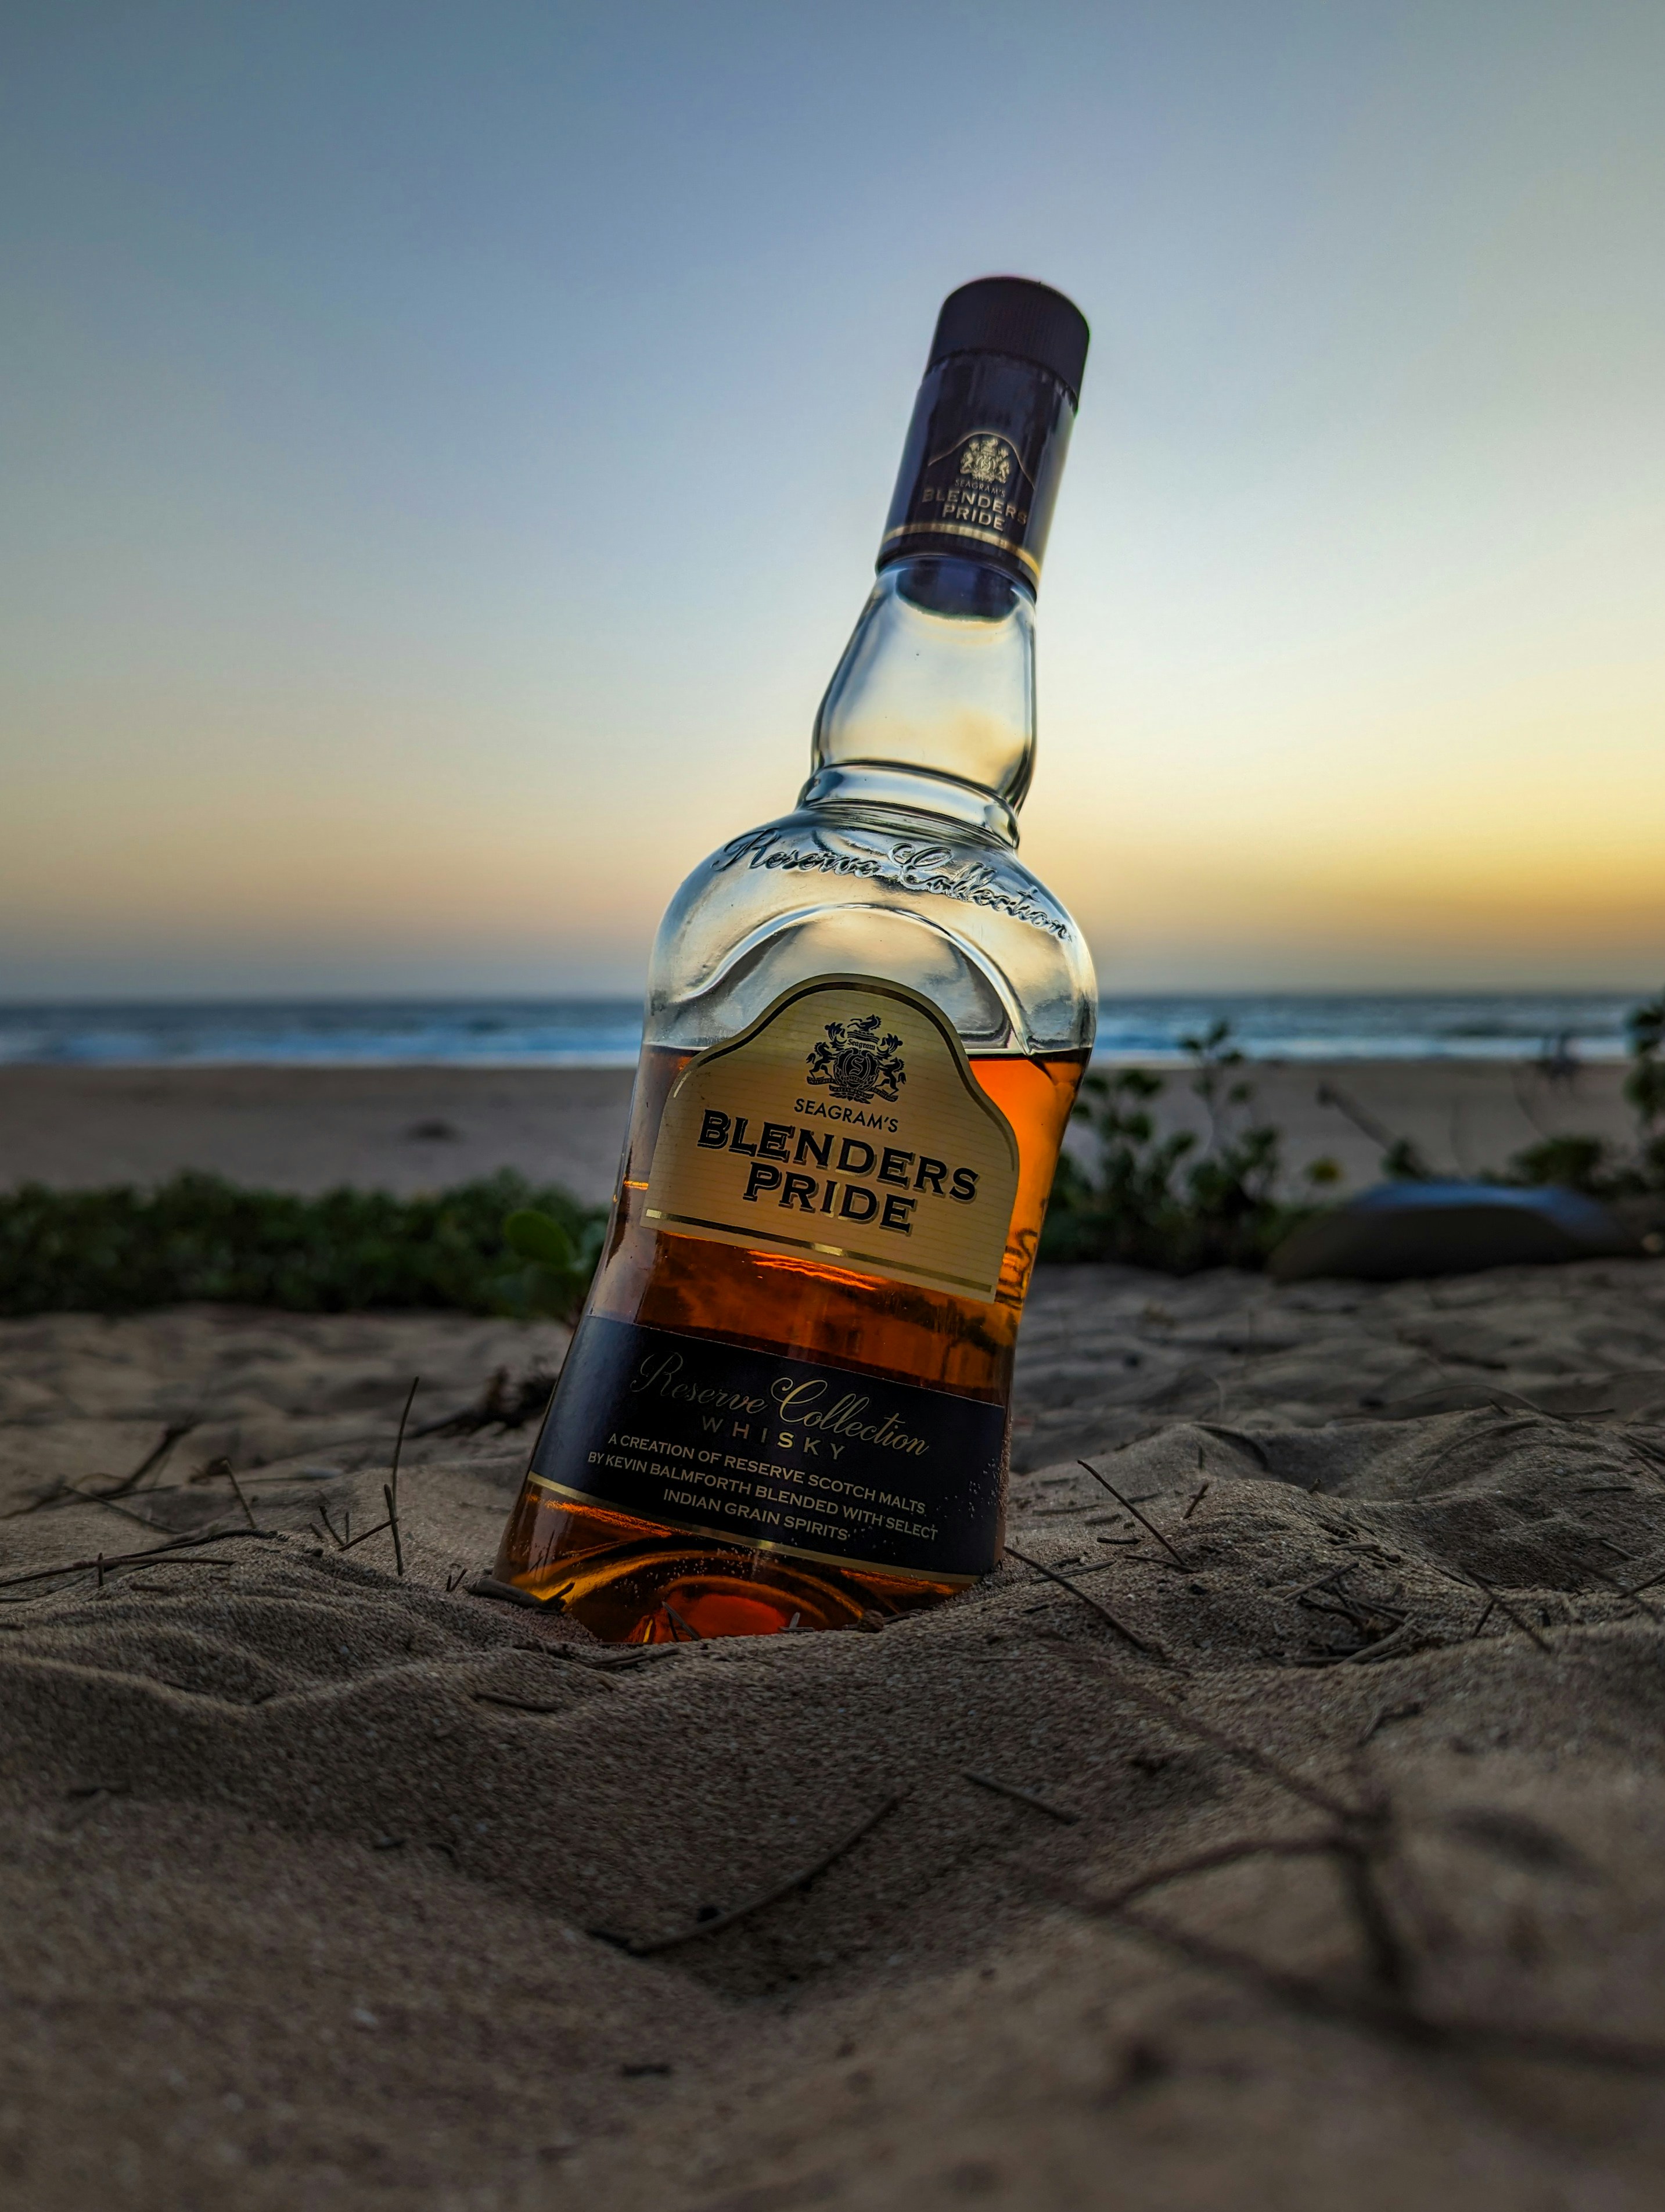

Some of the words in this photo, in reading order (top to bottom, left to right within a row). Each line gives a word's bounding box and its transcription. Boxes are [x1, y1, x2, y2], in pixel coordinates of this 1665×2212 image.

[922, 488, 1027, 524] BLENDERS
[955, 479, 1005, 498] SEAGRAM'S
[941, 503, 1005, 531] PRIDE
[710, 827, 882, 878] Reserve
[888, 843, 1073, 942] Collection
[847, 1038, 876, 1051] Seagram
[793, 1098, 899, 1133] SEAGRAM'S
[697, 1109, 979, 1204] BLENDERS
[742, 1161, 917, 1236] PRIDE
[630, 1351, 768, 1414] Reserve
[771, 1377, 929, 1456] Collection
[702, 1415, 846, 1460] WHISKY
[588, 1451, 605, 1464] BY
[605, 1454, 648, 1473] KEVIN
[650, 1463, 752, 1495] BALMFORTH
[755, 1485, 839, 1515] BLENDED
[843, 1505, 883, 1527] WITH
[885, 1517, 938, 1541] SELECT
[608, 1433, 617, 1445] A
[620, 1434, 695, 1459] CREATION
[698, 1450, 722, 1464] OF
[724, 1455, 805, 1484] RESERVE
[808, 1474, 876, 1501] SCOTCH
[879, 1491, 926, 1514] MALTS
[663, 1488, 721, 1512] INDIAN
[724, 1502, 781, 1525] GRAIN
[783, 1516, 848, 1541] SPIRITS
